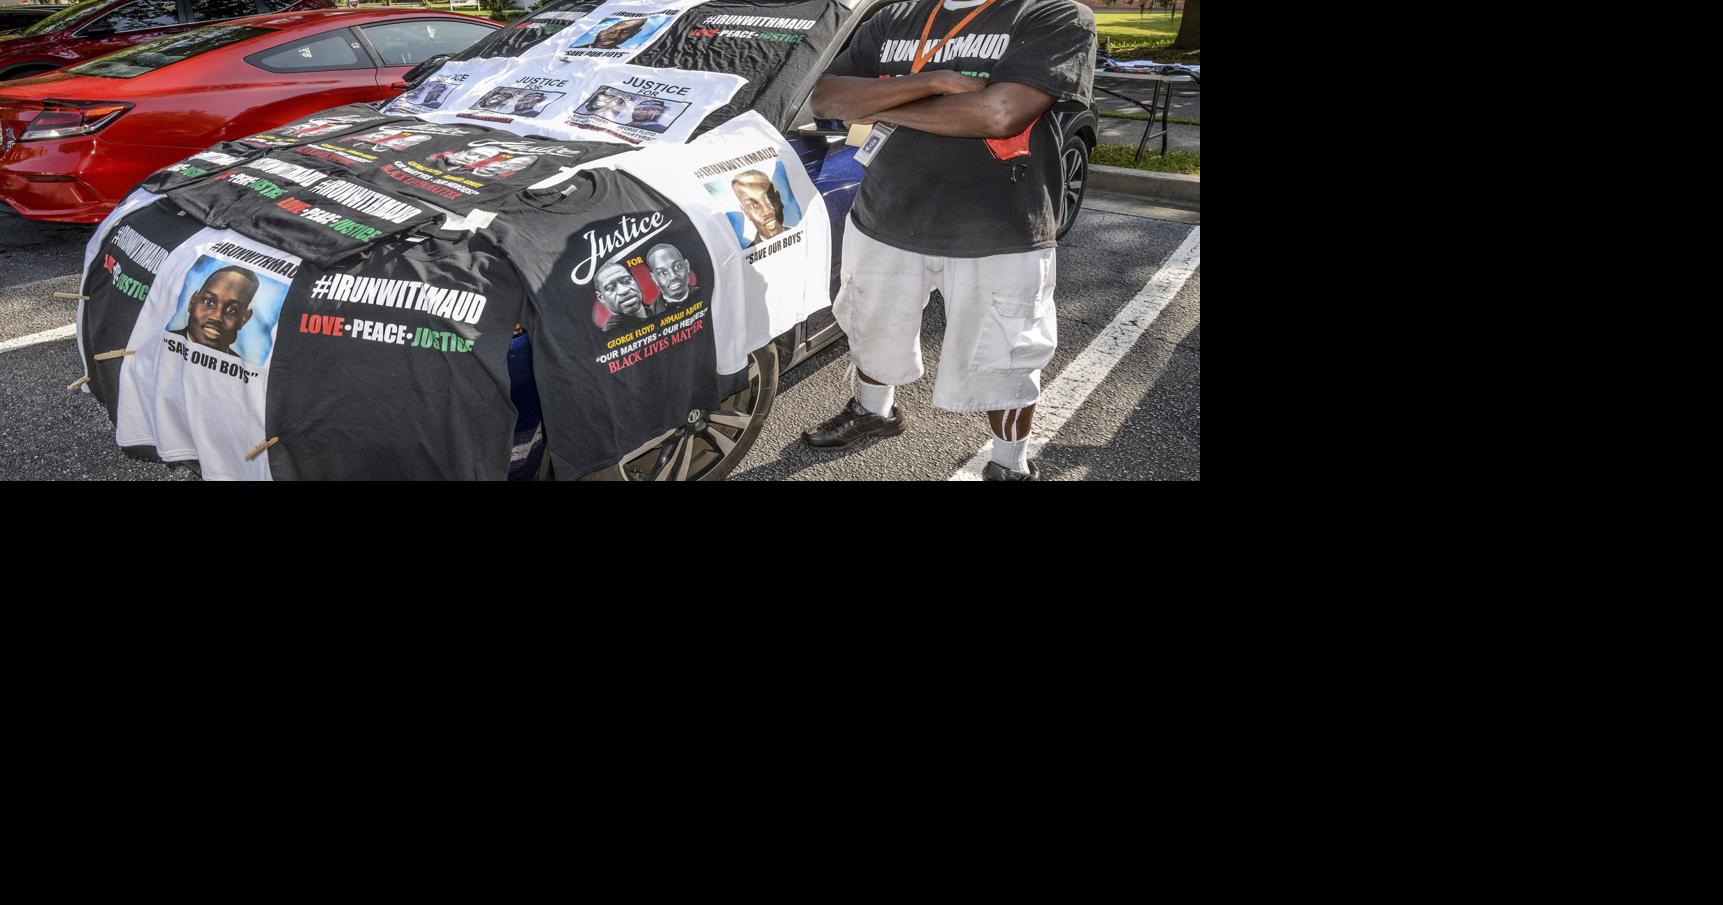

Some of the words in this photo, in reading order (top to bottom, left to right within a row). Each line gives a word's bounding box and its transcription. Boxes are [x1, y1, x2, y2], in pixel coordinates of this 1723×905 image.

[702, 14, 817, 30] #IRUNWITHMAUD
[516, 76, 569, 88] JUSTICE
[622, 76, 691, 96] JUSTICE
[638, 89, 659, 97] FOR
[694, 146, 778, 179] #IRUNWITHMAUD
[308, 179, 422, 224] #IRUNWITHMAUD
[328, 219, 382, 243] JUSTICE
[209, 241, 298, 279] #IRUNWITHMAU
[571, 212, 668, 285] Justice
[626, 256, 644, 268] FOR
[745, 247, 768, 265] "SAVE
[767, 240, 783, 255] OUR
[782, 230, 804, 249] BOYS"
[116, 273, 150, 301] JUSTIC
[311, 273, 487, 325] #IRUNWITHMAUD
[299, 313, 345, 337] LOVE
[351, 318, 407, 345] PEACE
[607, 332, 635, 349] GEORGE
[635, 323, 656, 339] FLOYD
[620, 333, 658, 356] MARTYRS
[662, 323, 679, 336] OUR
[608, 349, 642, 374] BLACK
[644, 336, 669, 358] LIVES
[671, 319, 703, 345] MATER
[191, 350, 218, 371] OUR
[220, 360, 258, 384] BOYS"
